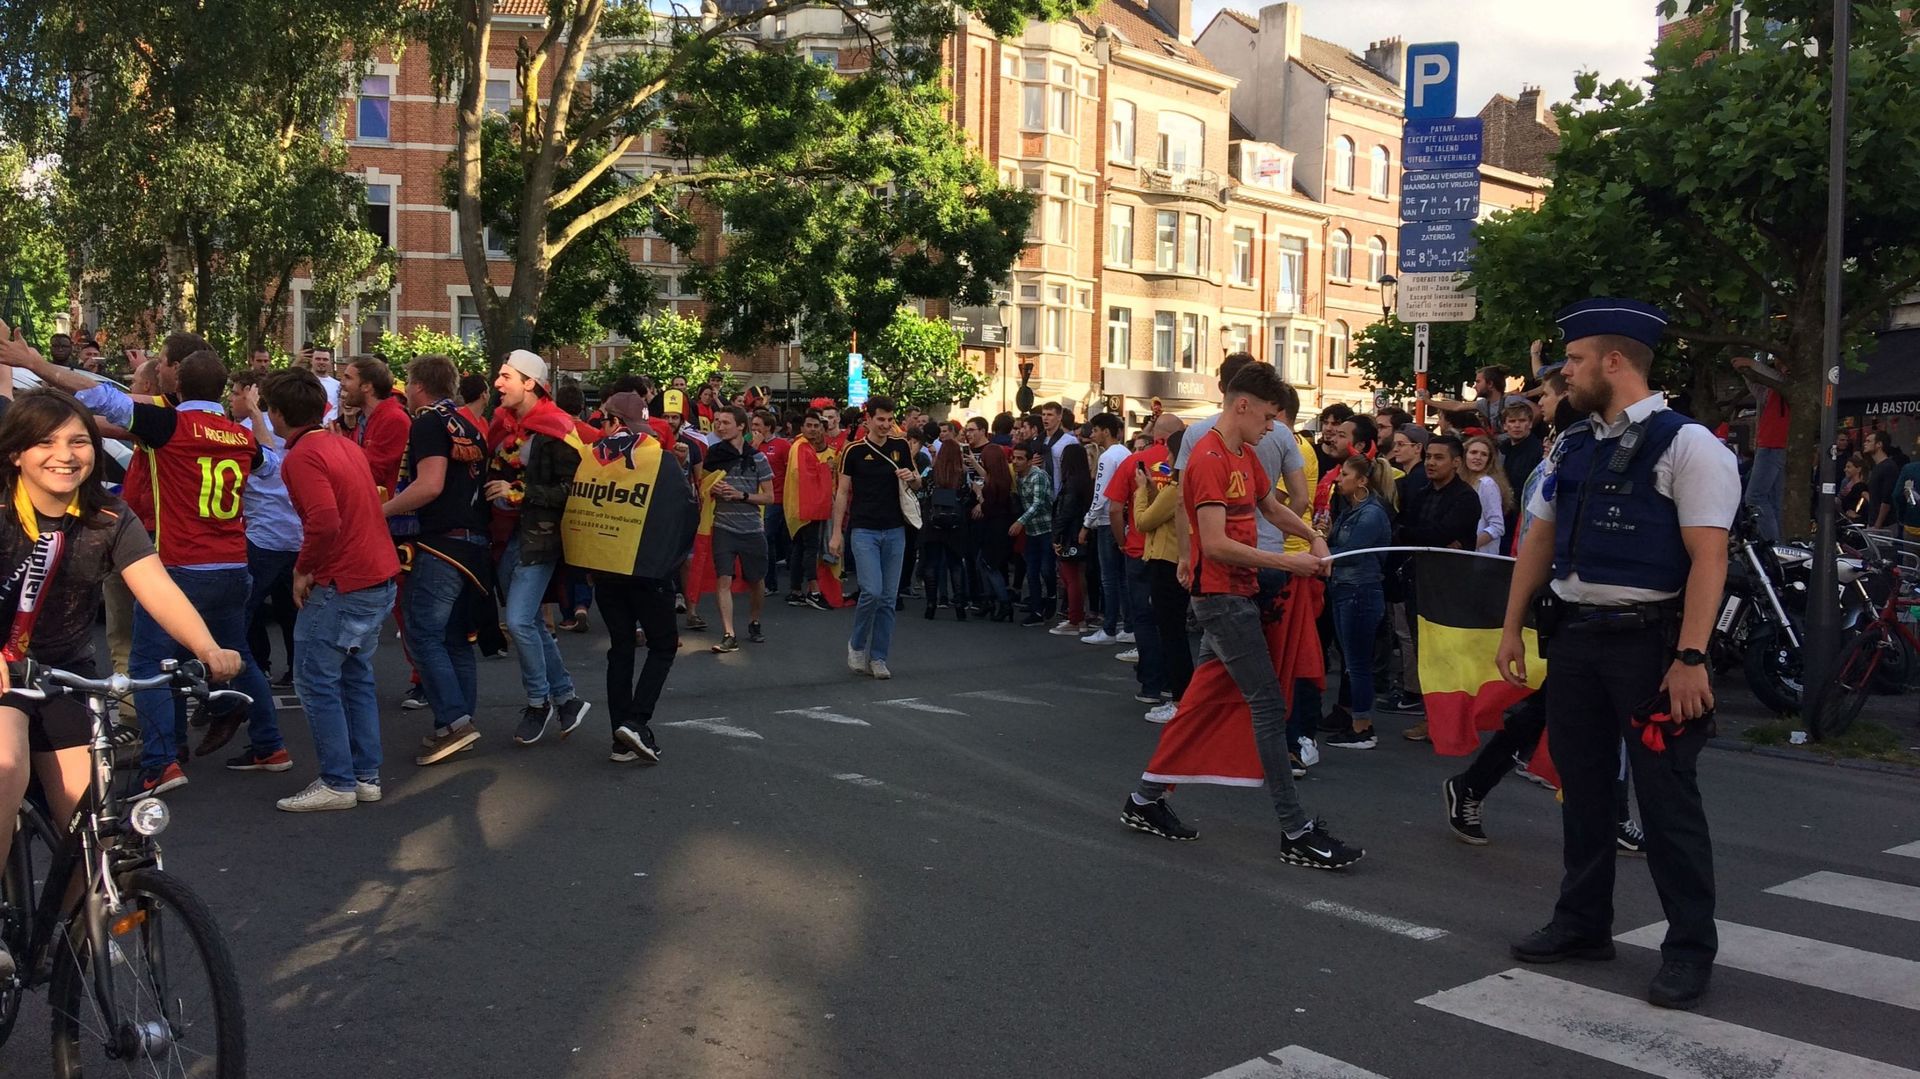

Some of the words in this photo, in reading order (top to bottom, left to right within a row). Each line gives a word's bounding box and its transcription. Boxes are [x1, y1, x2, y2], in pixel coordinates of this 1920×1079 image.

[1413, 54, 1450, 107] P
[1430, 125, 1456, 133] PAYANT
[1438, 134, 1478, 142] LIVRAISONS
[1425, 144, 1459, 153] BETALEND
[1435, 154, 1476, 162] LEVERINGEN
[1405, 197, 1416, 205] DE
[1419, 199, 1429, 213] 7
[1454, 197, 1471, 212] 17
[1473, 194, 1479, 202] H
[1438, 207, 1451, 215] TOT
[1473, 206, 1478, 214] U
[1427, 224, 1452, 232] SAMEDI
[1420, 233, 1456, 241] ZATERDAG
[1406, 248, 1416, 256] DE
[1418, 252, 1426, 263] 8
[1451, 251, 1464, 262] 12
[1402, 260, 1417, 268] VAN
[1417, 324, 1427, 333] 16
[1865, 402, 1880, 415] LA
[197, 456, 243, 520] 10
[1225, 470, 1247, 498] 20
